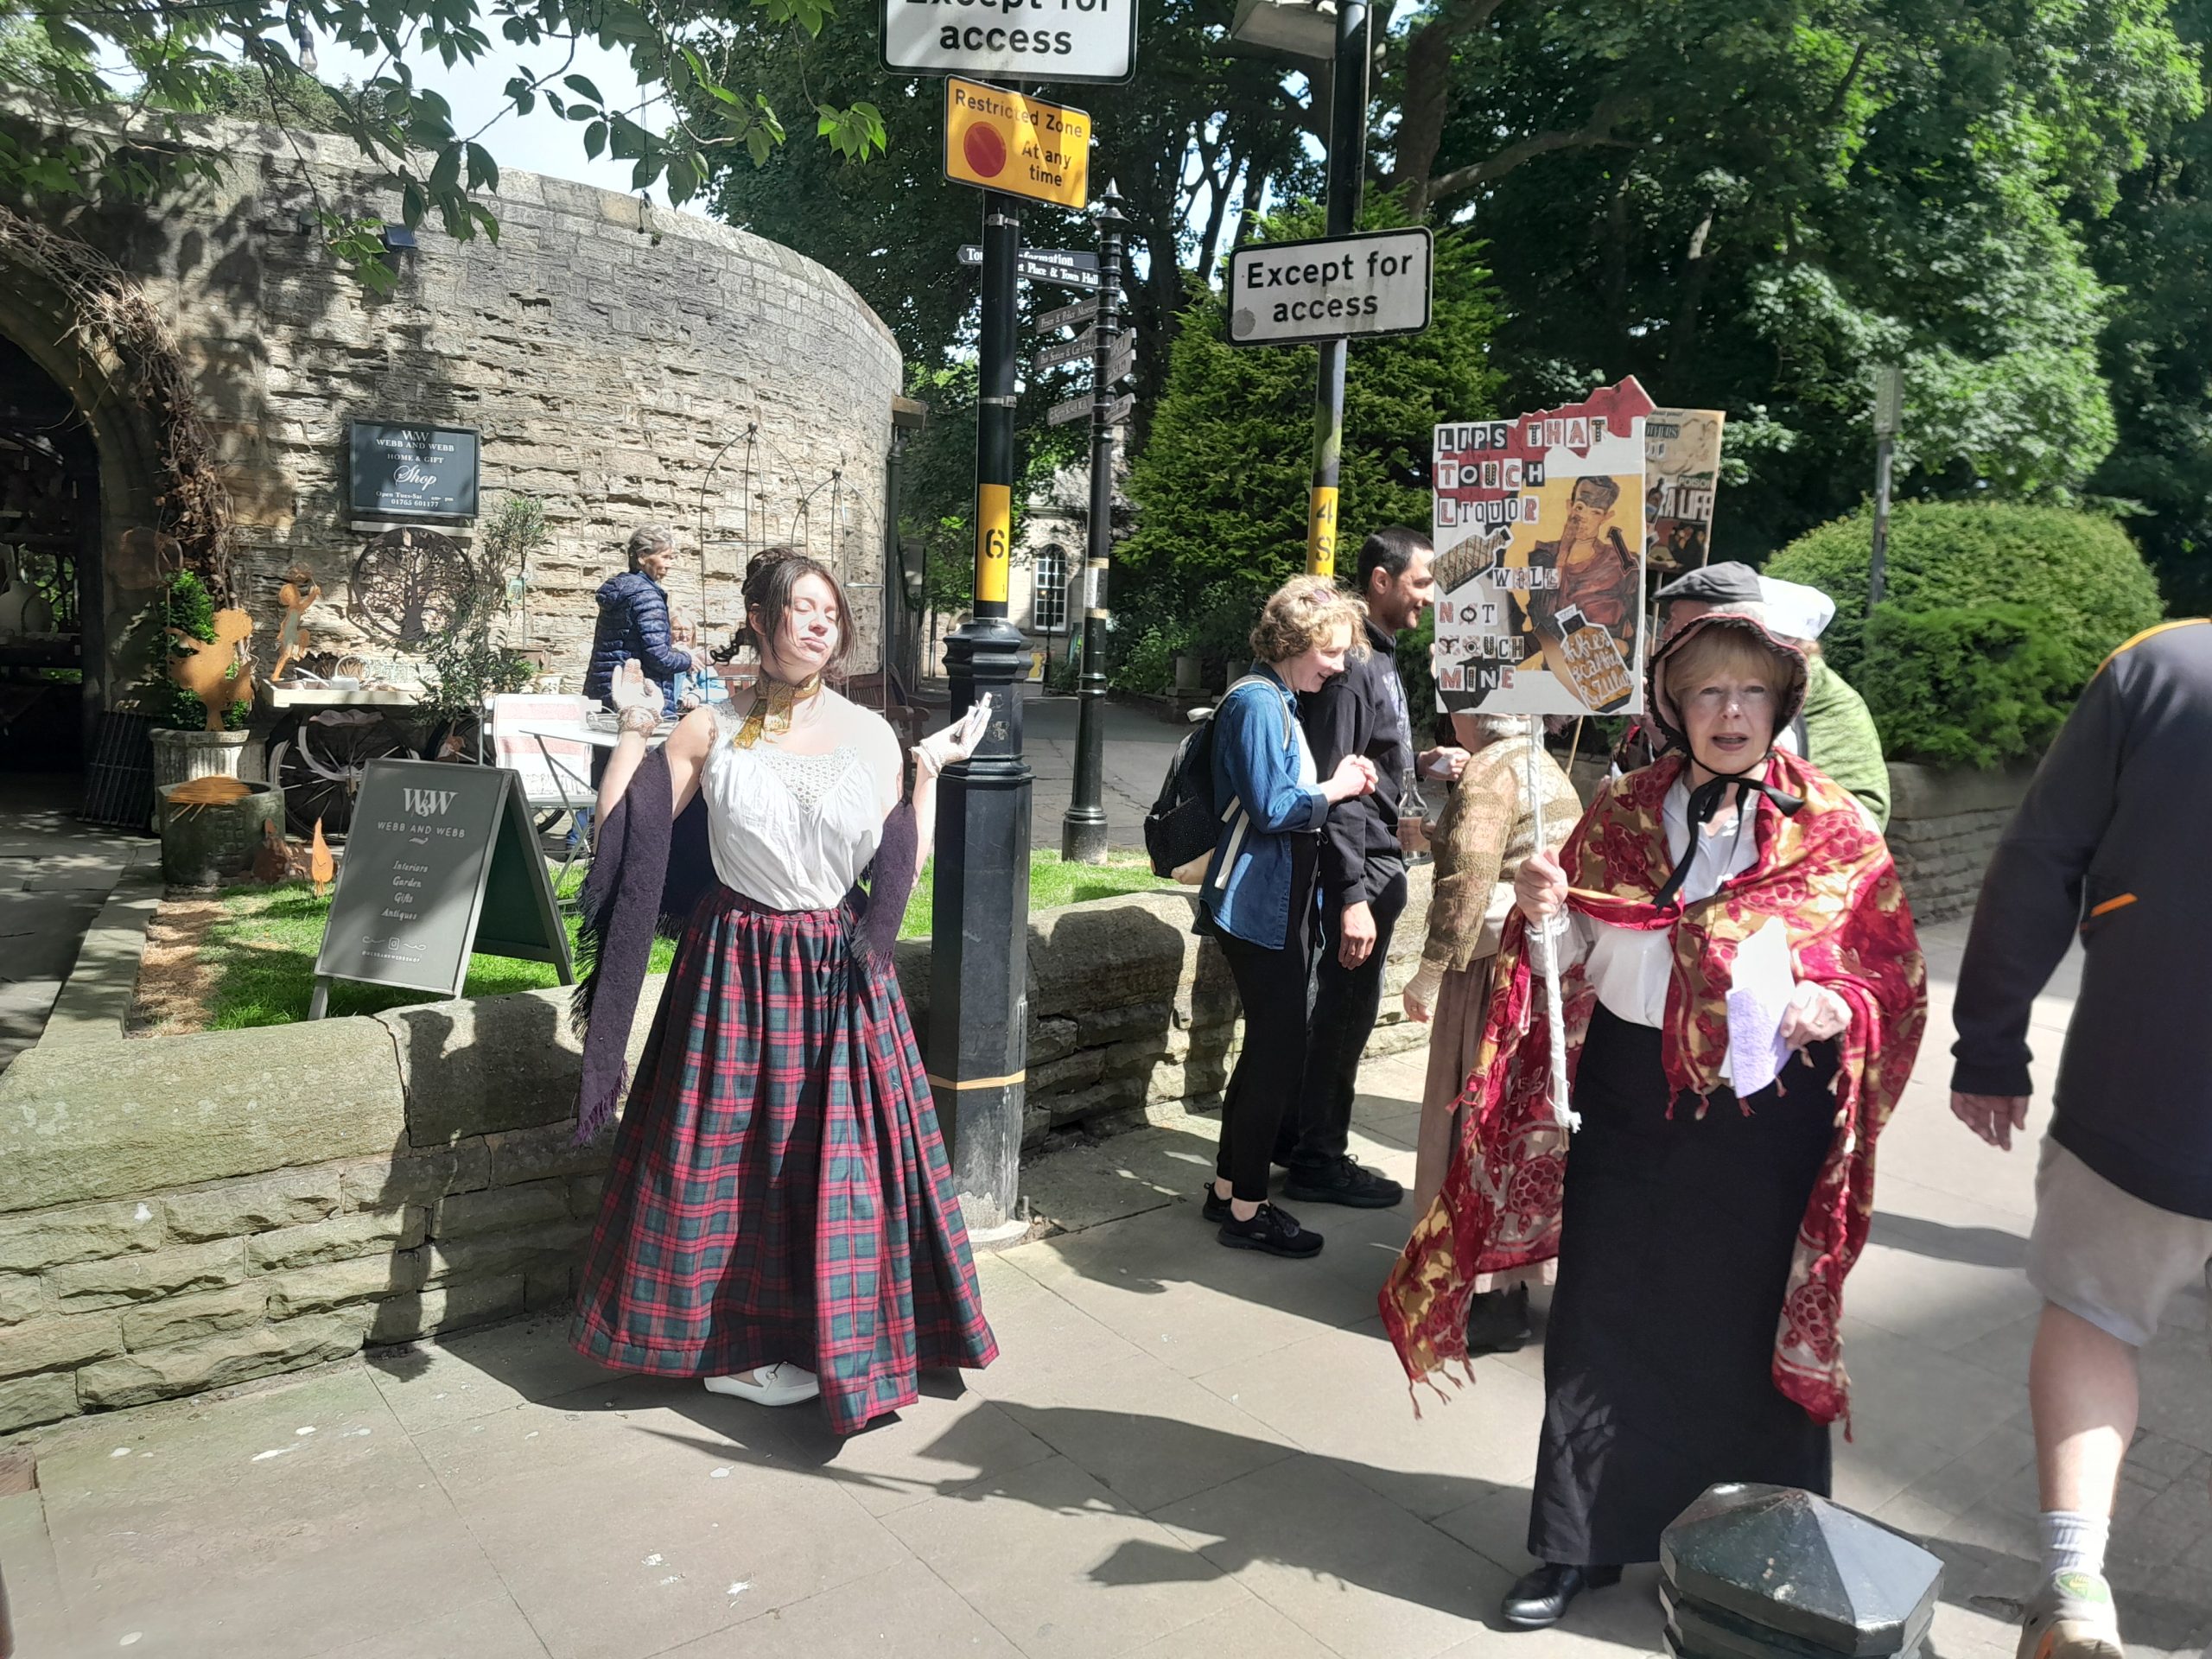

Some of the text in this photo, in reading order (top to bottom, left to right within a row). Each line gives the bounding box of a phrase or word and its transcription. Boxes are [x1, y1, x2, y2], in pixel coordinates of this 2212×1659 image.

[939, 24, 1072, 54] access
[955, 88, 1083, 138] Restricted Zone
[1021, 140, 1071, 170] At any
[1029, 164, 1063, 188] time
[1082, 271, 1099, 285] Hall
[1248, 251, 1413, 289] Except for
[1273, 294, 1378, 322] access
[376, 438, 404, 448] WEBB
[429, 443, 454, 452] WEBB
[1440, 419, 1605, 451] LIPS THAT
[387, 453, 413, 461] HOME
[393, 464, 437, 492] Shop
[1440, 462, 1543, 487] TOUCH
[375, 490, 393, 499] Open
[414, 499, 439, 508] 601177
[1440, 498, 1537, 524] LIQUOR
[985, 528, 1005, 560] 6
[1439, 601, 1495, 624] NOT
[1439, 635, 1523, 658] TOUCH
[1440, 665, 1515, 690] MINE
[403, 787, 460, 817] W&W
[377, 821, 465, 838] WEBB AND WEBB
[392, 860, 429, 873] Interiors
[392, 875, 422, 888] Garden
[394, 892, 414, 904] Gifts
[381, 907, 417, 921] Antiques
